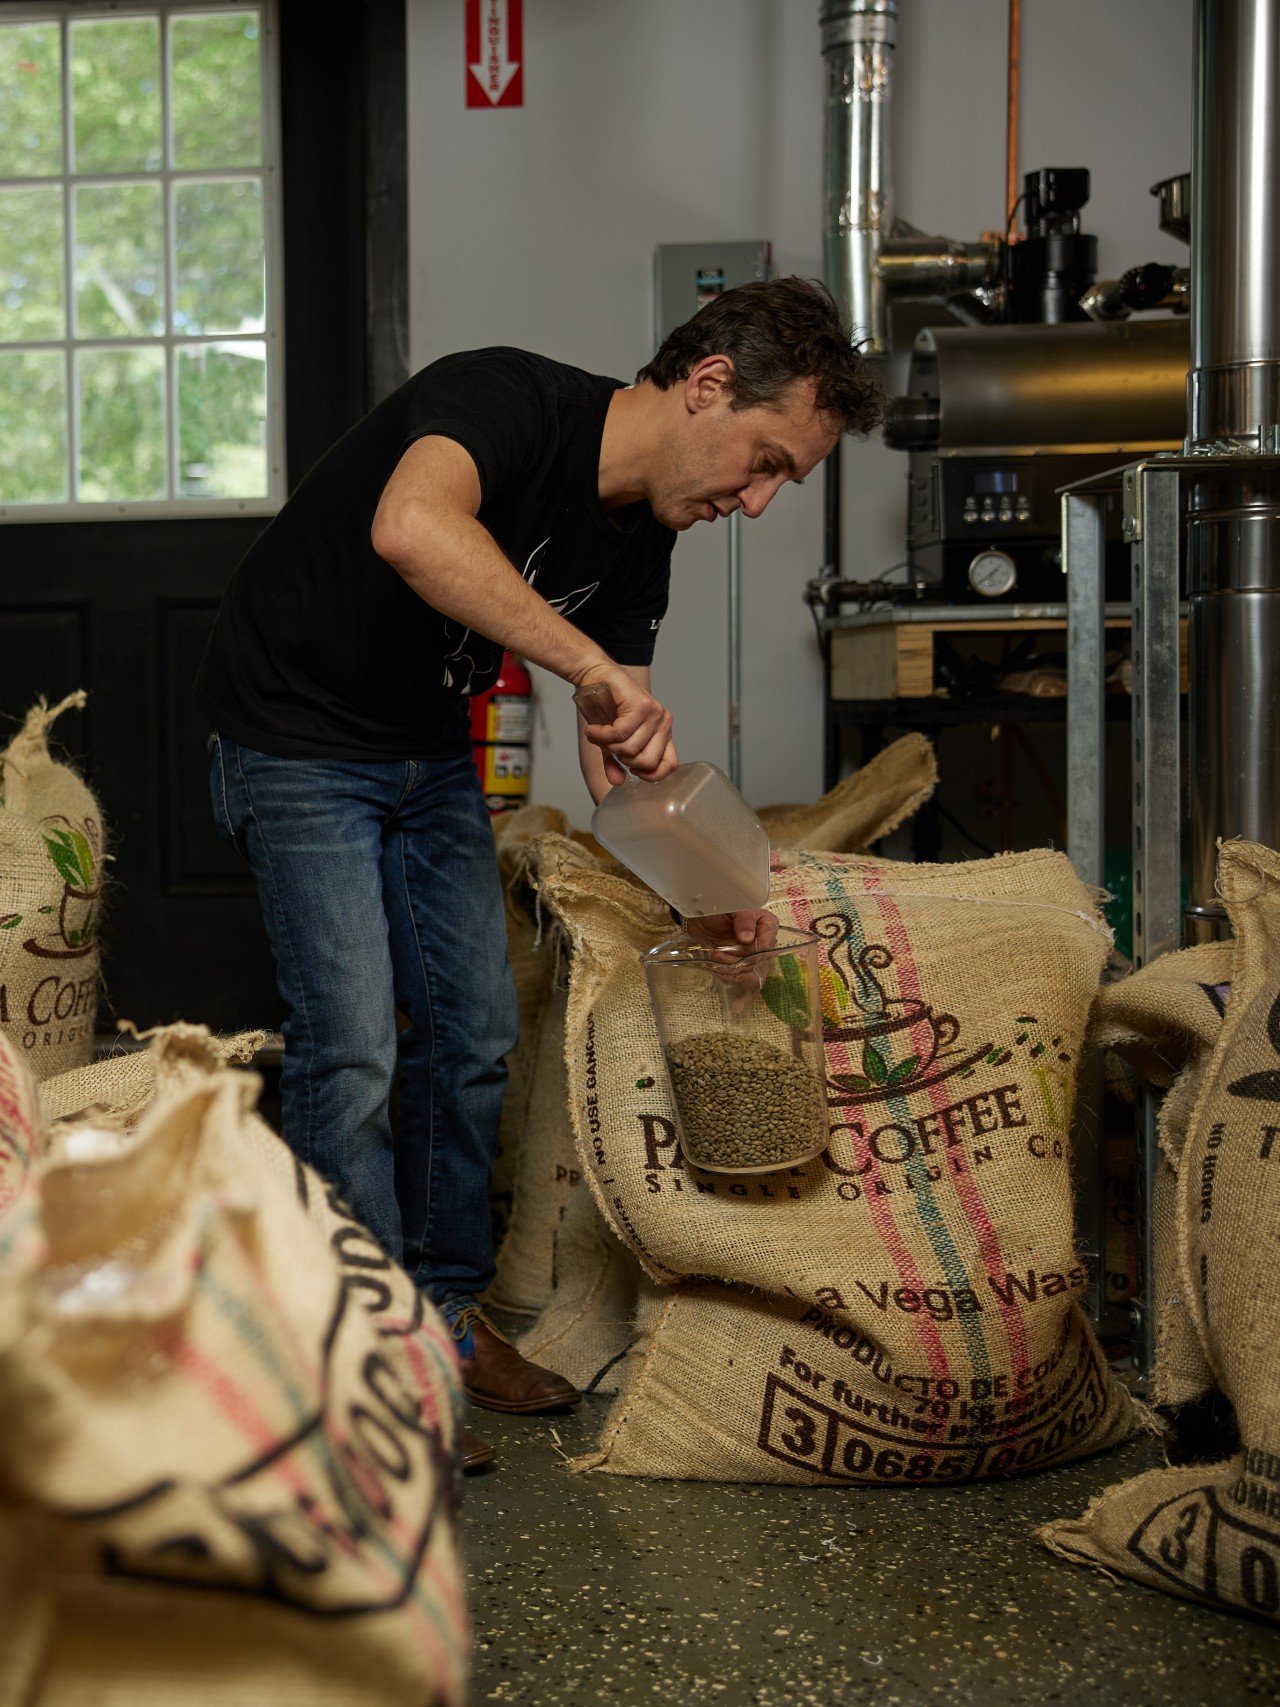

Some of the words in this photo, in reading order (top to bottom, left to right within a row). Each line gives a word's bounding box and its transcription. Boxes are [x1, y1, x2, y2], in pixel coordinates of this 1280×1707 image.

[586, 1092, 602, 1135] USE
[820, 1083, 1029, 1178] COFFEE
[591, 1135, 607, 1166] NO
[644, 1172, 801, 1199] SINGLE
[836, 1145, 994, 1201] ORIGIN
[854, 1279, 984, 1323] Vega
[798, 1306, 961, 1401] PRODUCTO
[971, 1374, 1008, 1401] DE
[780, 1344, 827, 1390] For
[832, 1378, 945, 1435] further
[912, 1395, 951, 1419] 70
[781, 1406, 817, 1457] 3
[842, 1437, 967, 1480] 0685
[1157, 1502, 1201, 1571] 3
